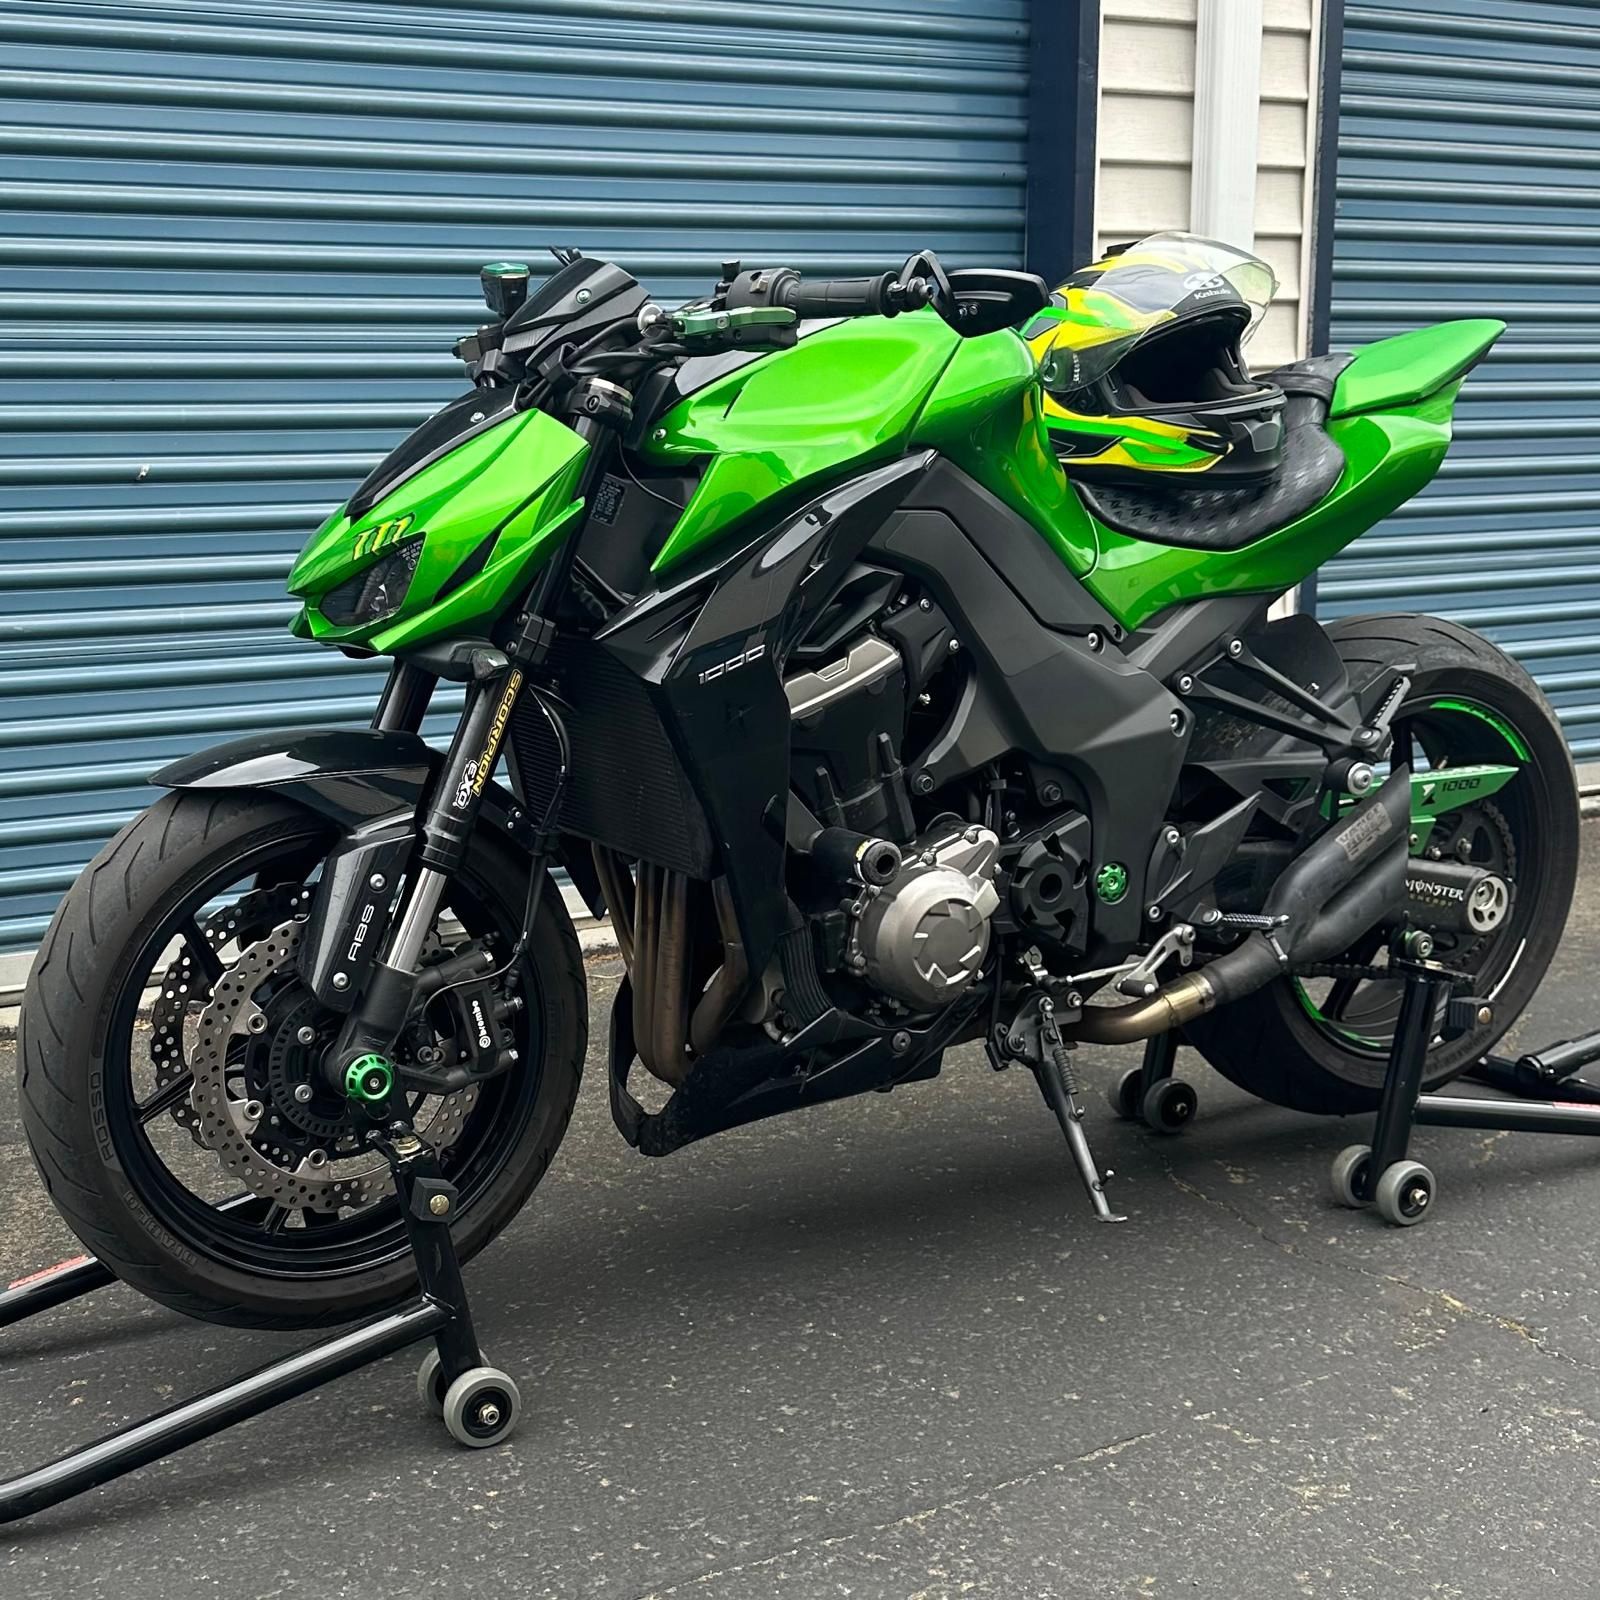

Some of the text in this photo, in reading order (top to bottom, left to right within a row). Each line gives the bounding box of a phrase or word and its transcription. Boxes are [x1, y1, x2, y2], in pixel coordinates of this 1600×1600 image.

[698, 644, 766, 685] 1000
[472, 670, 522, 795] SCORPION
[1442, 779, 1481, 792] 1000
[347, 904, 375, 961] ABS
[472, 1000, 488, 1038] brembo
[89, 1071, 114, 1161] ROSSO
[122, 1190, 198, 1267] DIABLO
